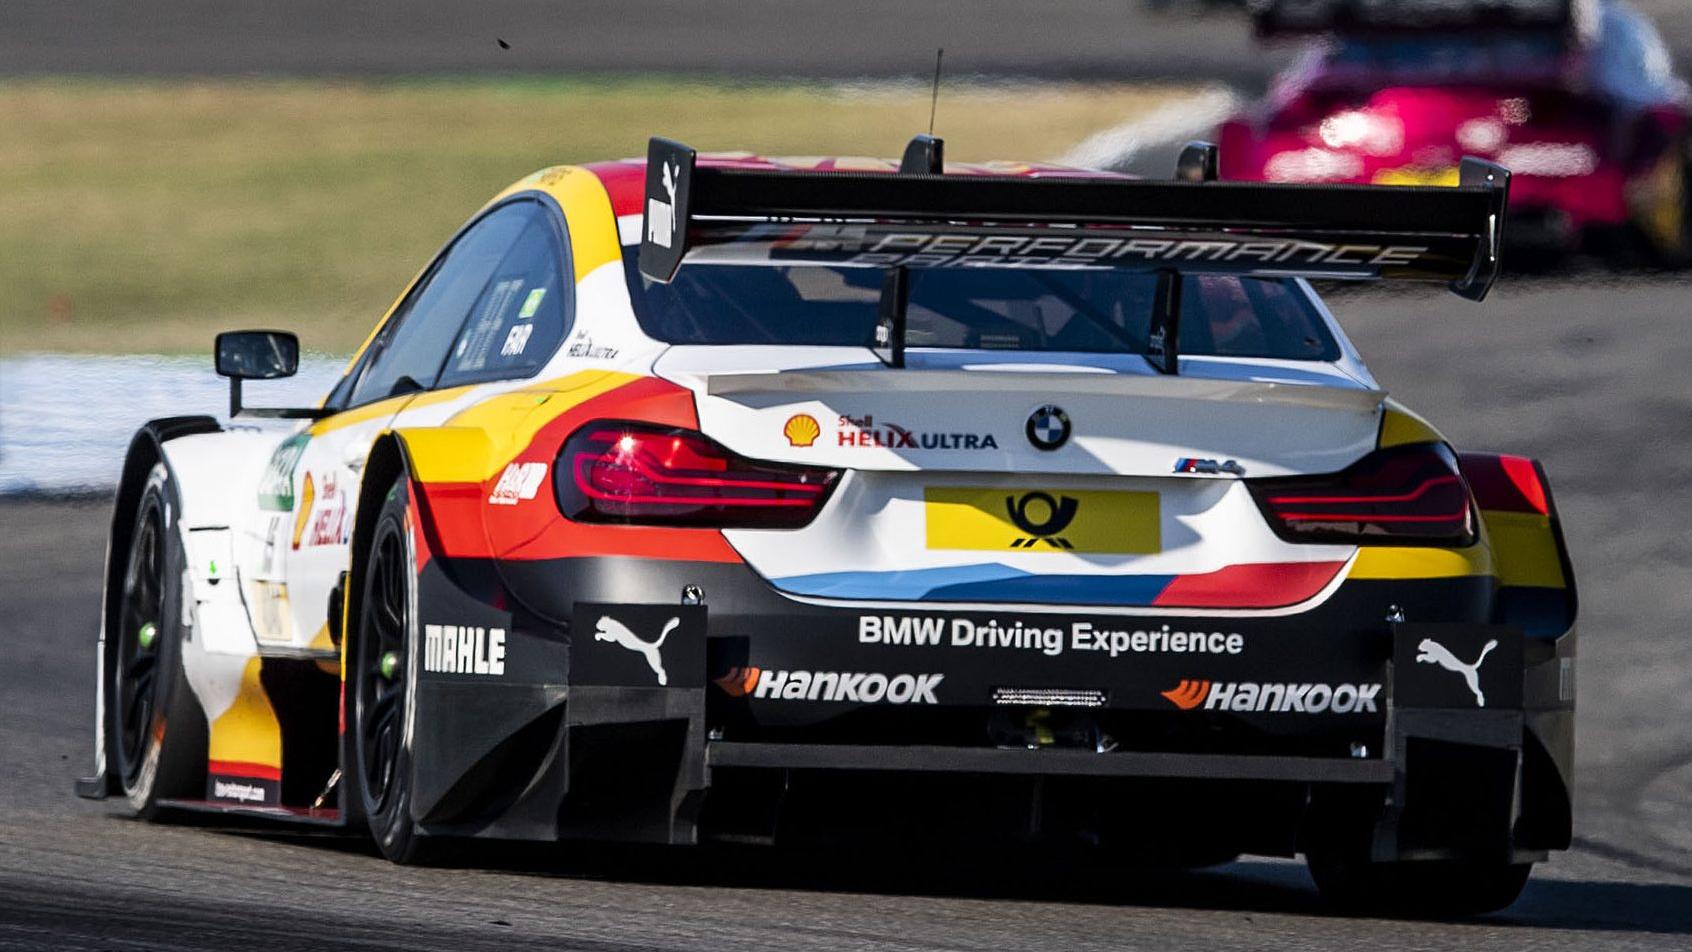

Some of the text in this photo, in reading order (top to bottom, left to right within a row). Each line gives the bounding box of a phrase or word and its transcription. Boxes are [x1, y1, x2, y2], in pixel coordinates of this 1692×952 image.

[869, 233, 1430, 266] PERFORMANCE
[838, 415, 873, 427] Shell
[838, 423, 999, 450] HELIX ULTRA
[424, 624, 506, 675] MAHLE
[859, 615, 1245, 657] BMW Driving Experience
